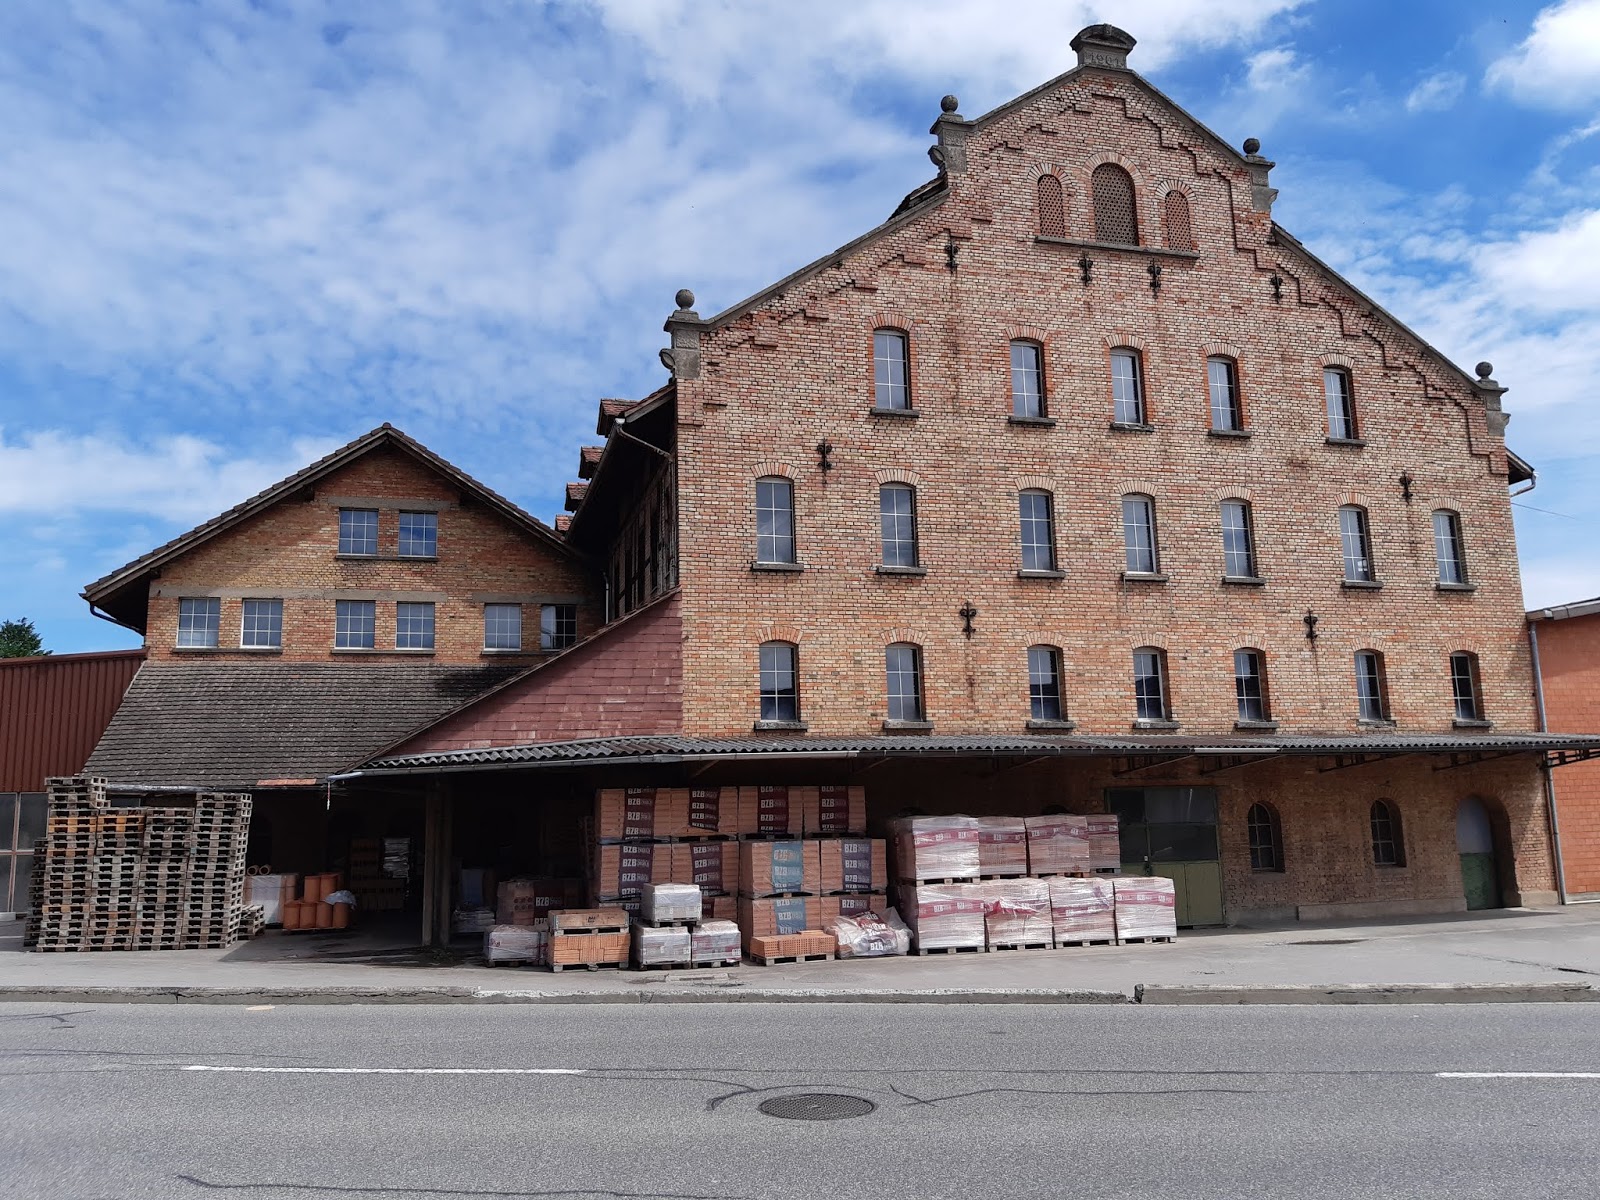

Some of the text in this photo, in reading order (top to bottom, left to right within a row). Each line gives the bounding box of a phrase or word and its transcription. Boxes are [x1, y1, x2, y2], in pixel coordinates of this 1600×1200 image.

[761, 799, 773, 808] BZB
[822, 799, 834, 807] BZB
[627, 811, 640, 820] BZB
[626, 827, 639, 835] BZB
[623, 845, 637, 854] BZB
[693, 846, 707, 854] BZB
[844, 844, 857, 853] BZB
[622, 859, 636, 867] BZB
[695, 859, 707, 868] BZB
[845, 860, 857, 868] BZB
[775, 866, 787, 876] BZB
[622, 873, 636, 881] BZB
[695, 873, 708, 883] BZB
[536, 897, 549, 906] BZB
[842, 900, 855, 908] BZB
[778, 911, 792, 920] BZB
[870, 942, 883, 950] BZB
